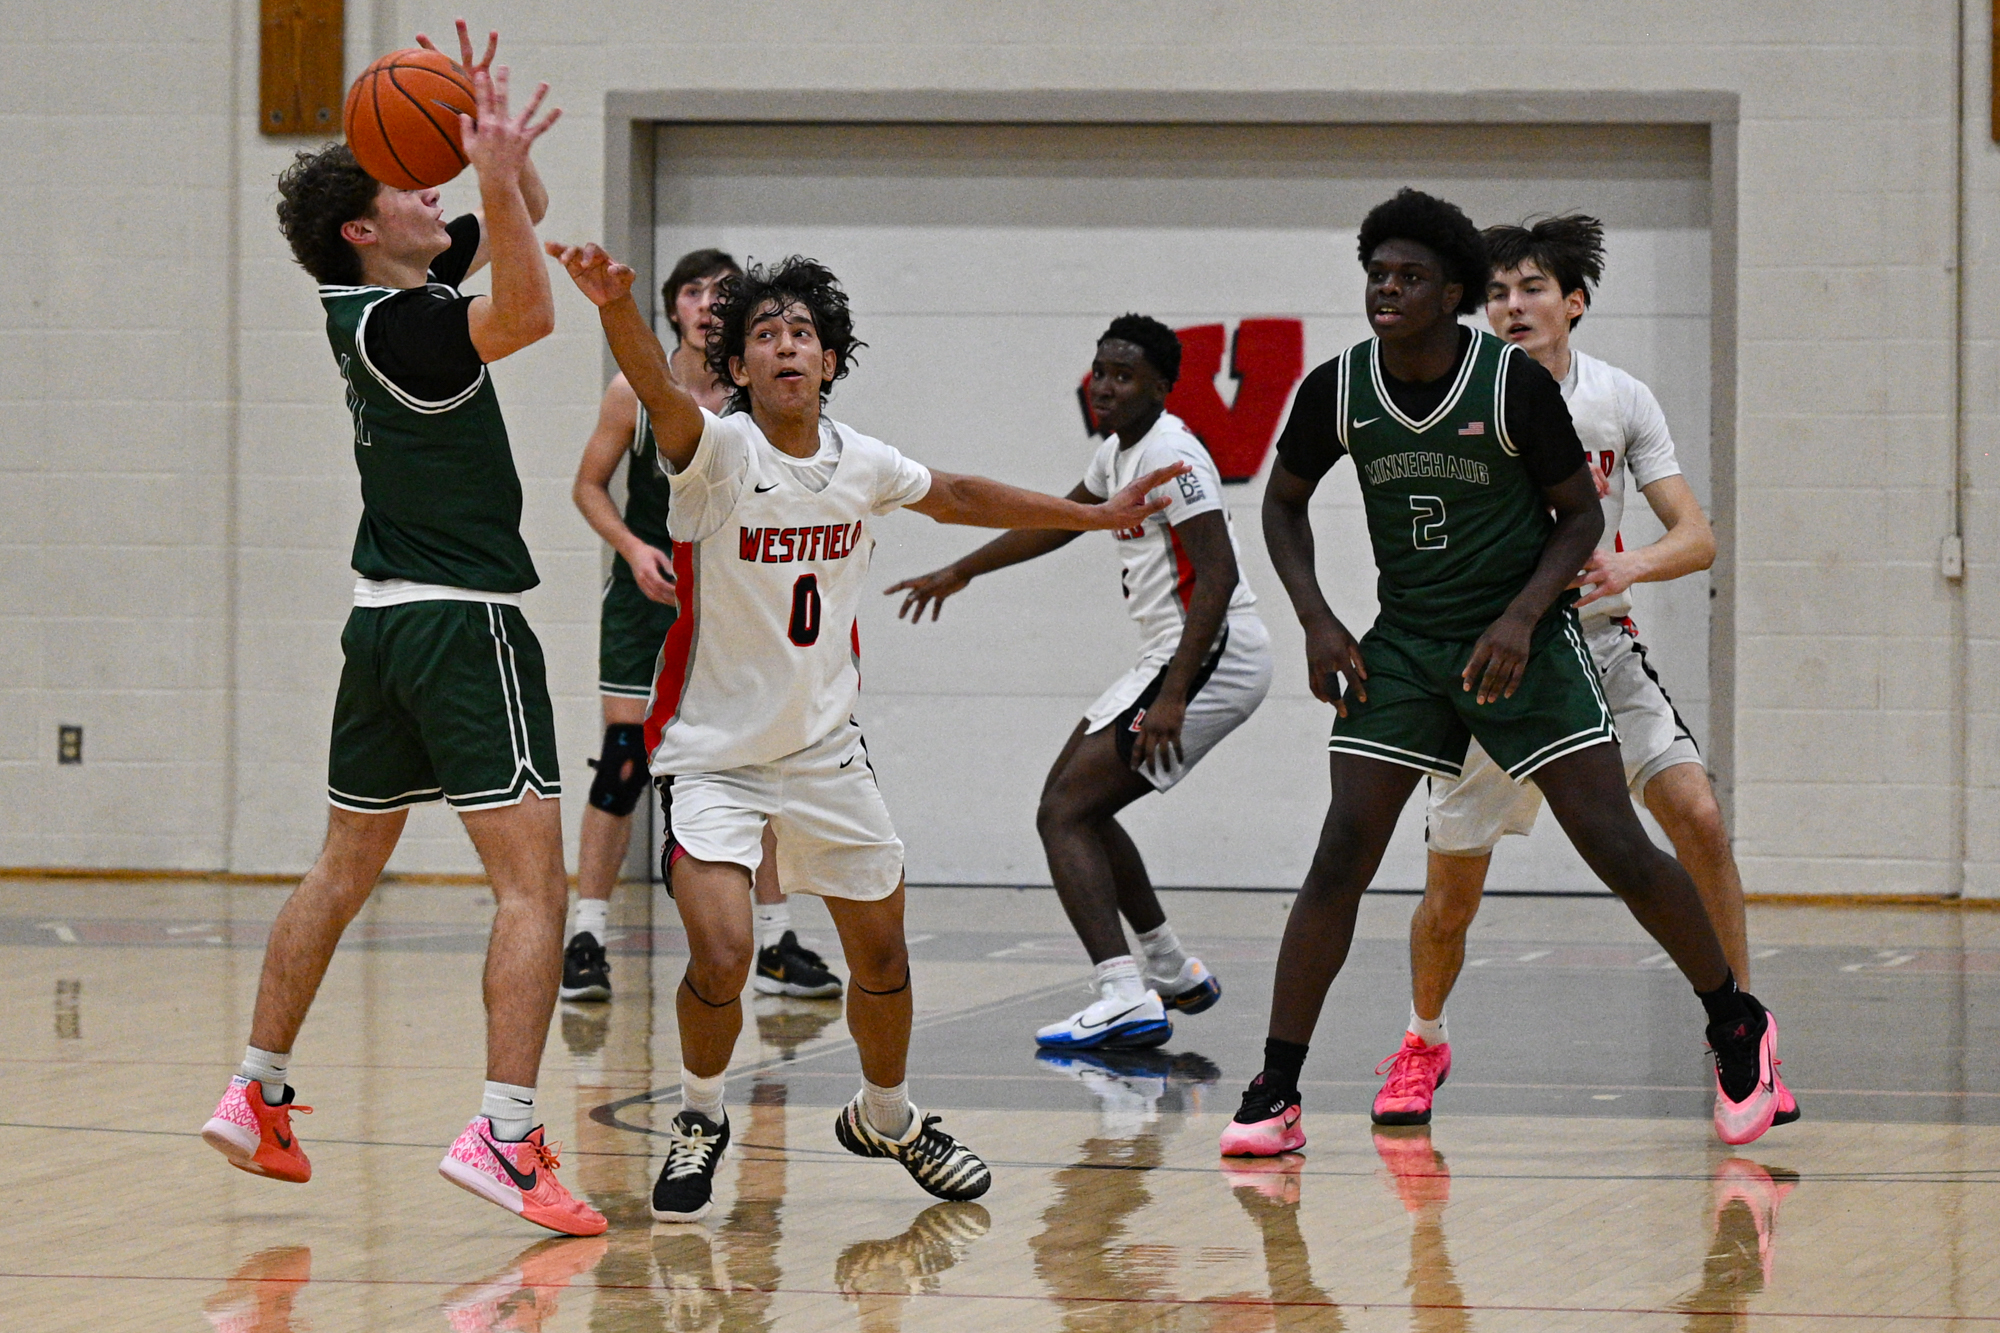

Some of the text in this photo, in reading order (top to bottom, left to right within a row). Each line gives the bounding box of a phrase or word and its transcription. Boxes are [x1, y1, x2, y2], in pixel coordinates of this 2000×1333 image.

[1364, 451, 1490, 486] MINNECHAUG
[739, 519, 862, 564] WESTFIELD
[1409, 494, 1448, 551] 2
[787, 572, 822, 648] 0
